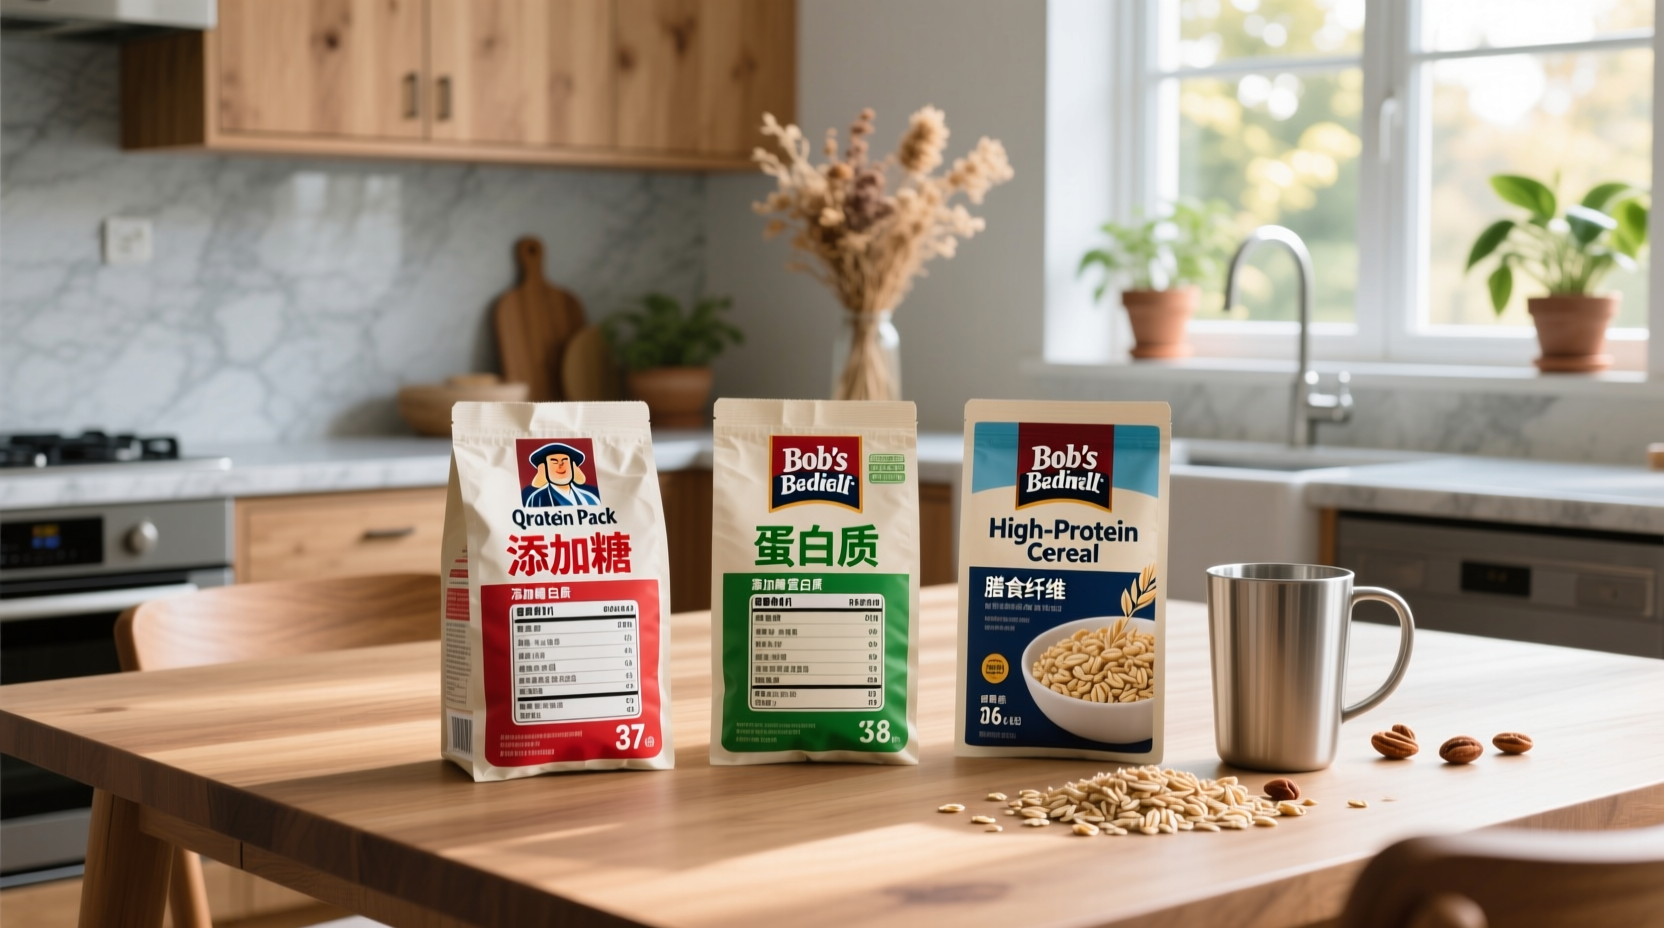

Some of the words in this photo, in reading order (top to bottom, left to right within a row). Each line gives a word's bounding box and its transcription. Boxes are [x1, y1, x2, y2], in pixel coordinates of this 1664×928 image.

[782, 445, 848, 473] Bob's
[1031, 443, 1098, 471] Bob's
[577, 507, 617, 526] Pack
[989, 516, 1139, 546] High-Protein
[506, 531, 632, 577] 添加糖
[754, 524, 879, 568] 蛋白质
[1027, 542, 1099, 563] Cereal
[984, 575, 1066, 601] 膳食纤维
[615, 723, 645, 751] 37
[858, 719, 891, 744] 38
